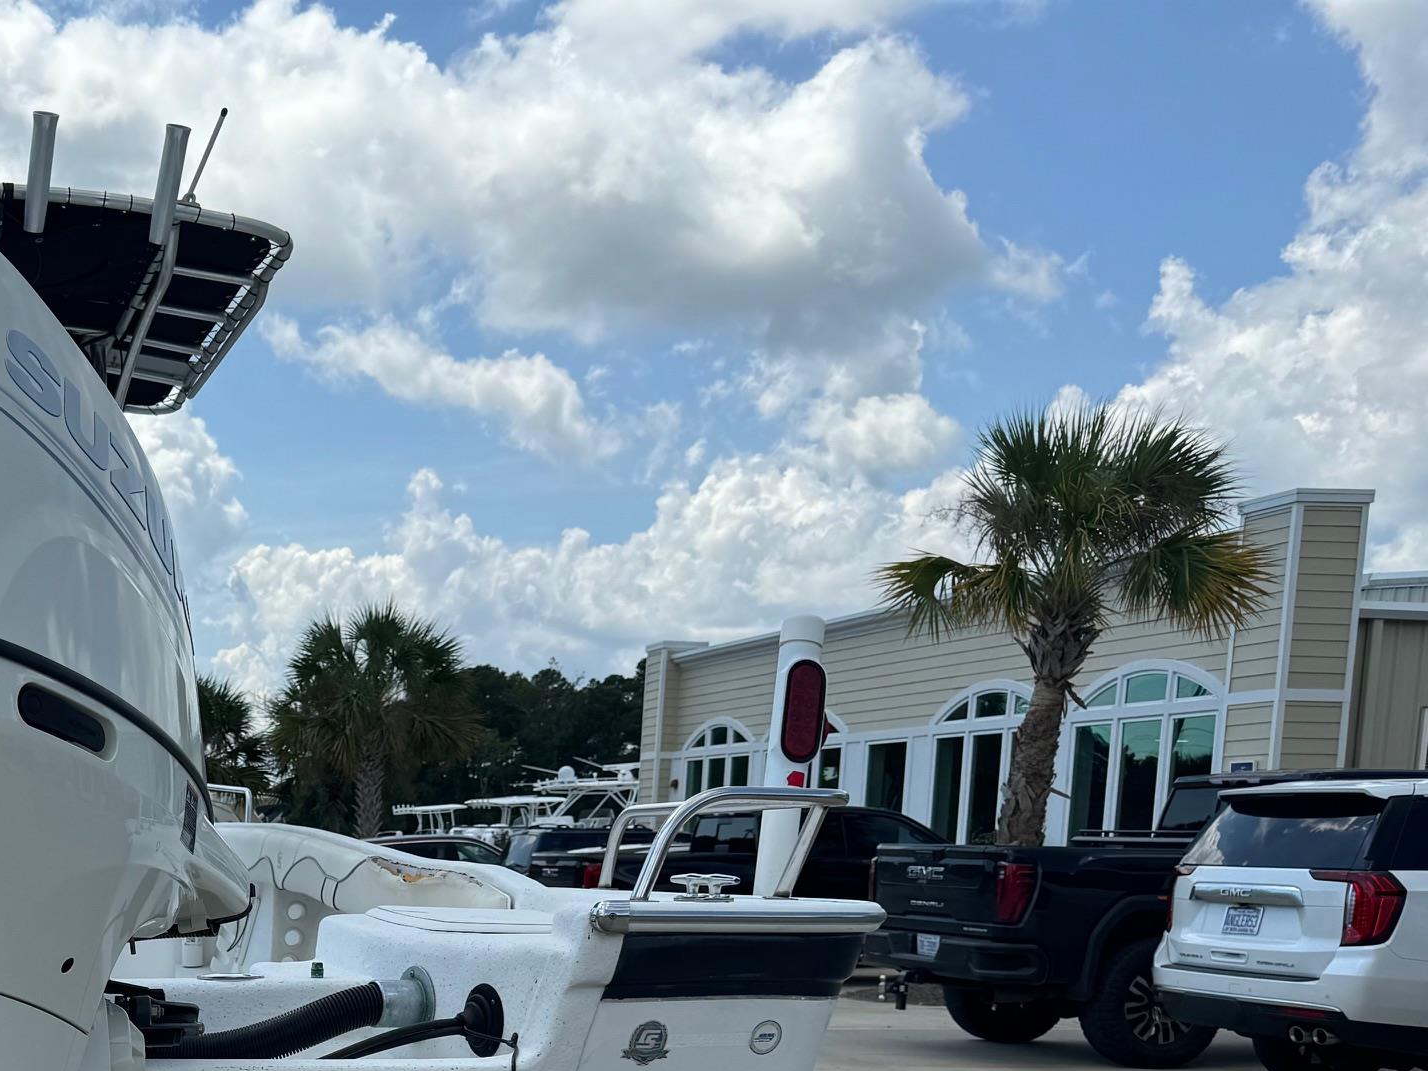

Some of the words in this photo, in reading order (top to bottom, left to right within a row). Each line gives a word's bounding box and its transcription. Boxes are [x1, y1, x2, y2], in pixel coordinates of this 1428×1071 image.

[906, 865, 945, 880] GMC
[1220, 887, 1253, 897] GMC
[909, 899, 945, 908] DENALI
